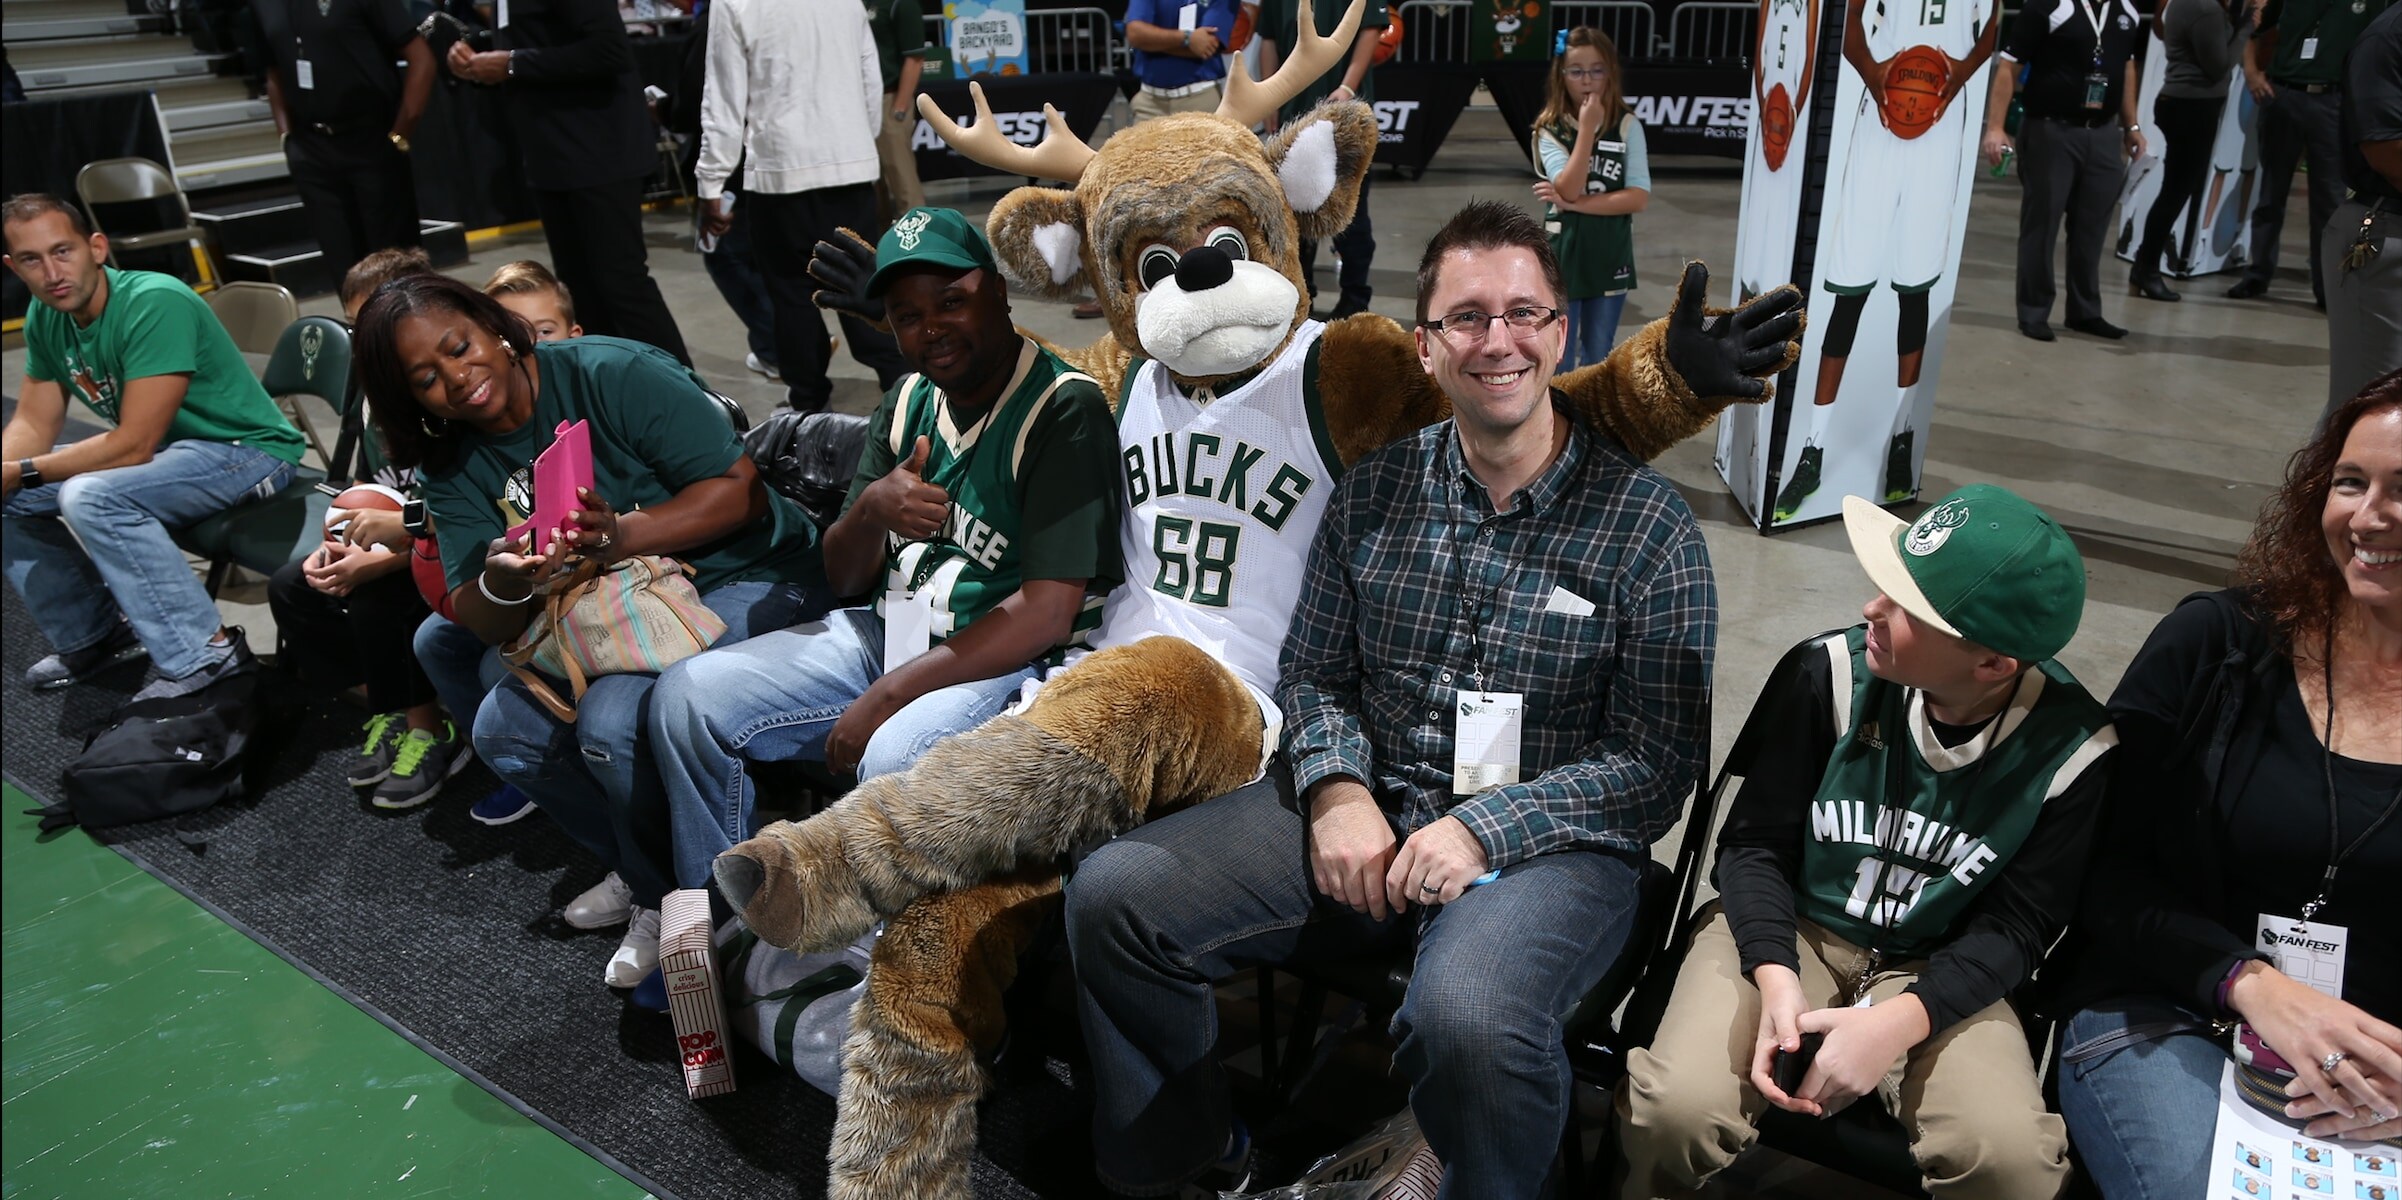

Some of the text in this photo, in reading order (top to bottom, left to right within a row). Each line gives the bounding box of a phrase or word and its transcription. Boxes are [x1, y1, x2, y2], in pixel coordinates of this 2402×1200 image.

[963, 20, 1008, 35] BANGO'S
[959, 33, 1014, 49] BACKYARD
[1778, 25, 1788, 69] 5
[1896, 68, 1940, 90] SPALDING
[1373, 100, 1420, 131] ST
[1686, 96, 1751, 127] FES
[990, 110, 1066, 147] ES
[1122, 430, 1315, 535] BUCKS
[1153, 513, 1243, 608] 68
[2279, 935, 2305, 947] FAN
[2306, 939, 2340, 952] FEST
[673, 981, 704, 992] delicious
[678, 973, 696, 983] crisp
[678, 1030, 717, 1052] POP
[683, 1045, 725, 1067] CORN
